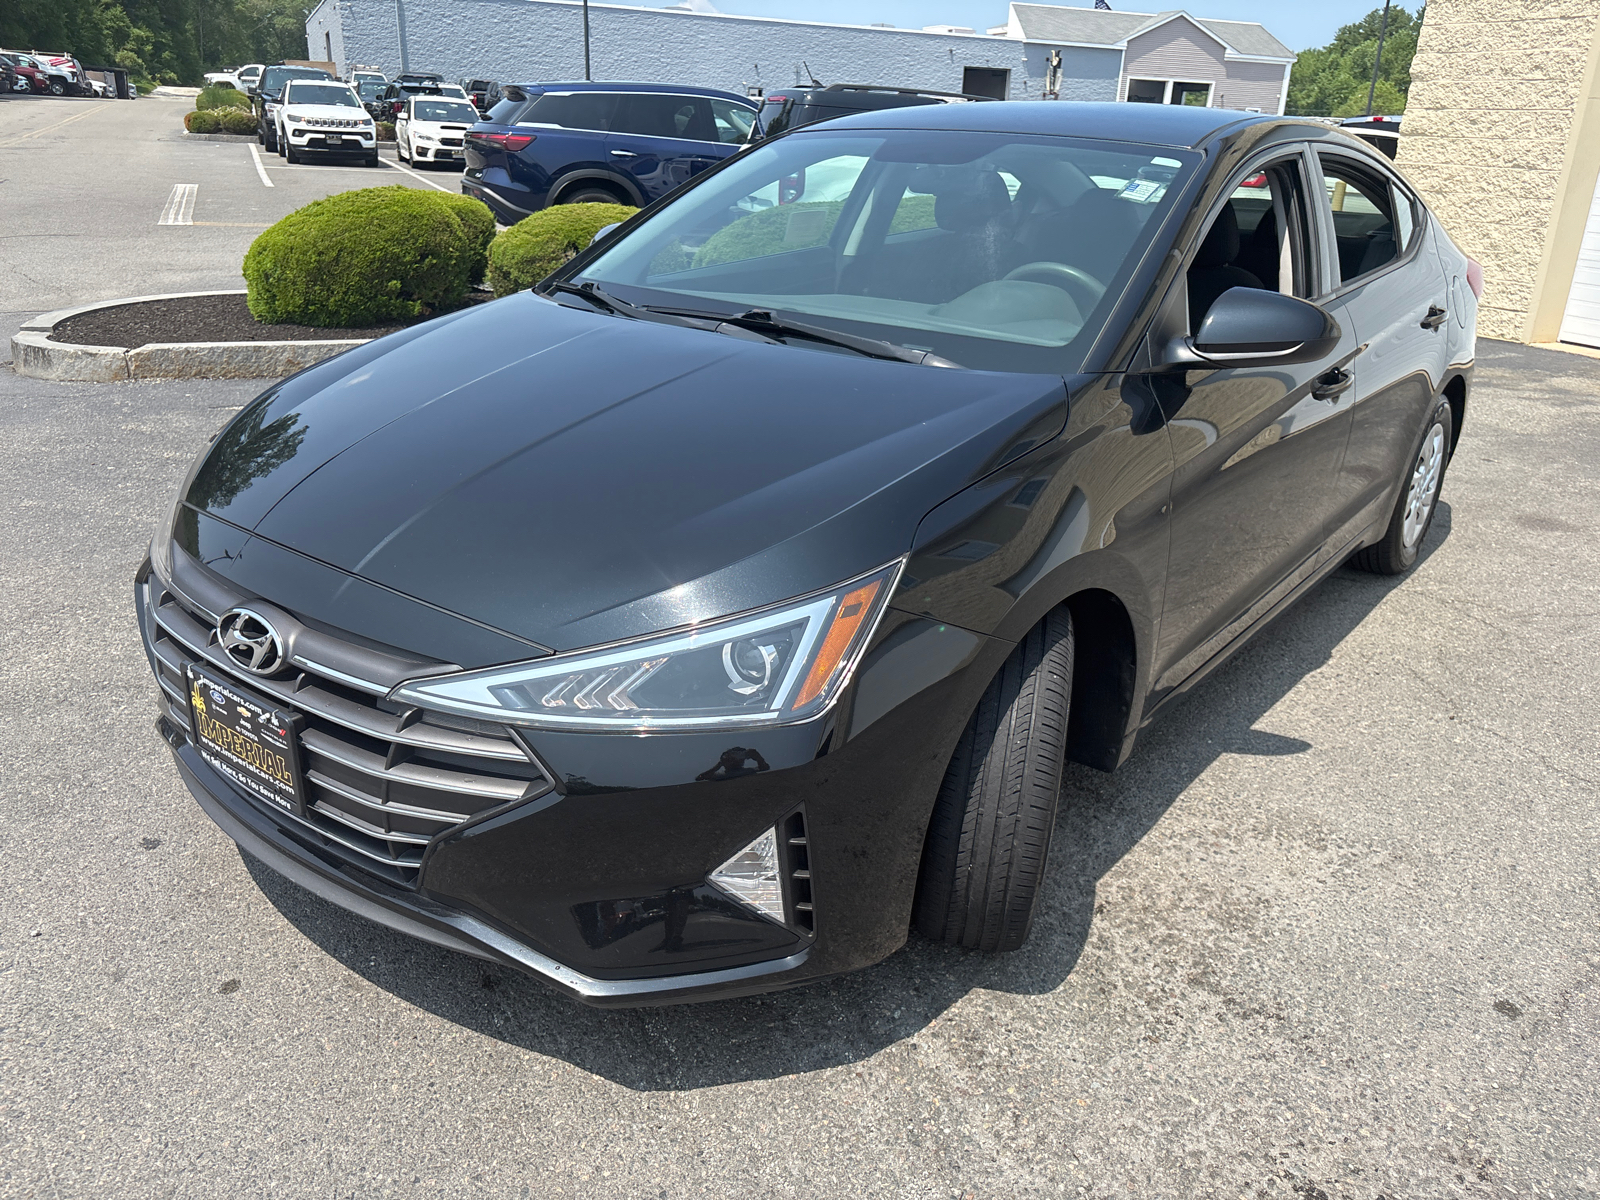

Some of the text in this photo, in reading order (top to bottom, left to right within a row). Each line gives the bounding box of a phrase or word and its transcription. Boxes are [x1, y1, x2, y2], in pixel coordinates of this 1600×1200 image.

[240, 718, 252, 731] Jeep
[241, 728, 259, 742] TOYOTA
[197, 709, 293, 786] IMPERIAL
[201, 750, 211, 762] We
[238, 773, 247, 783] So
[247, 777, 259, 790] You
[260, 785, 275, 800] Save
[275, 794, 291, 810] More
